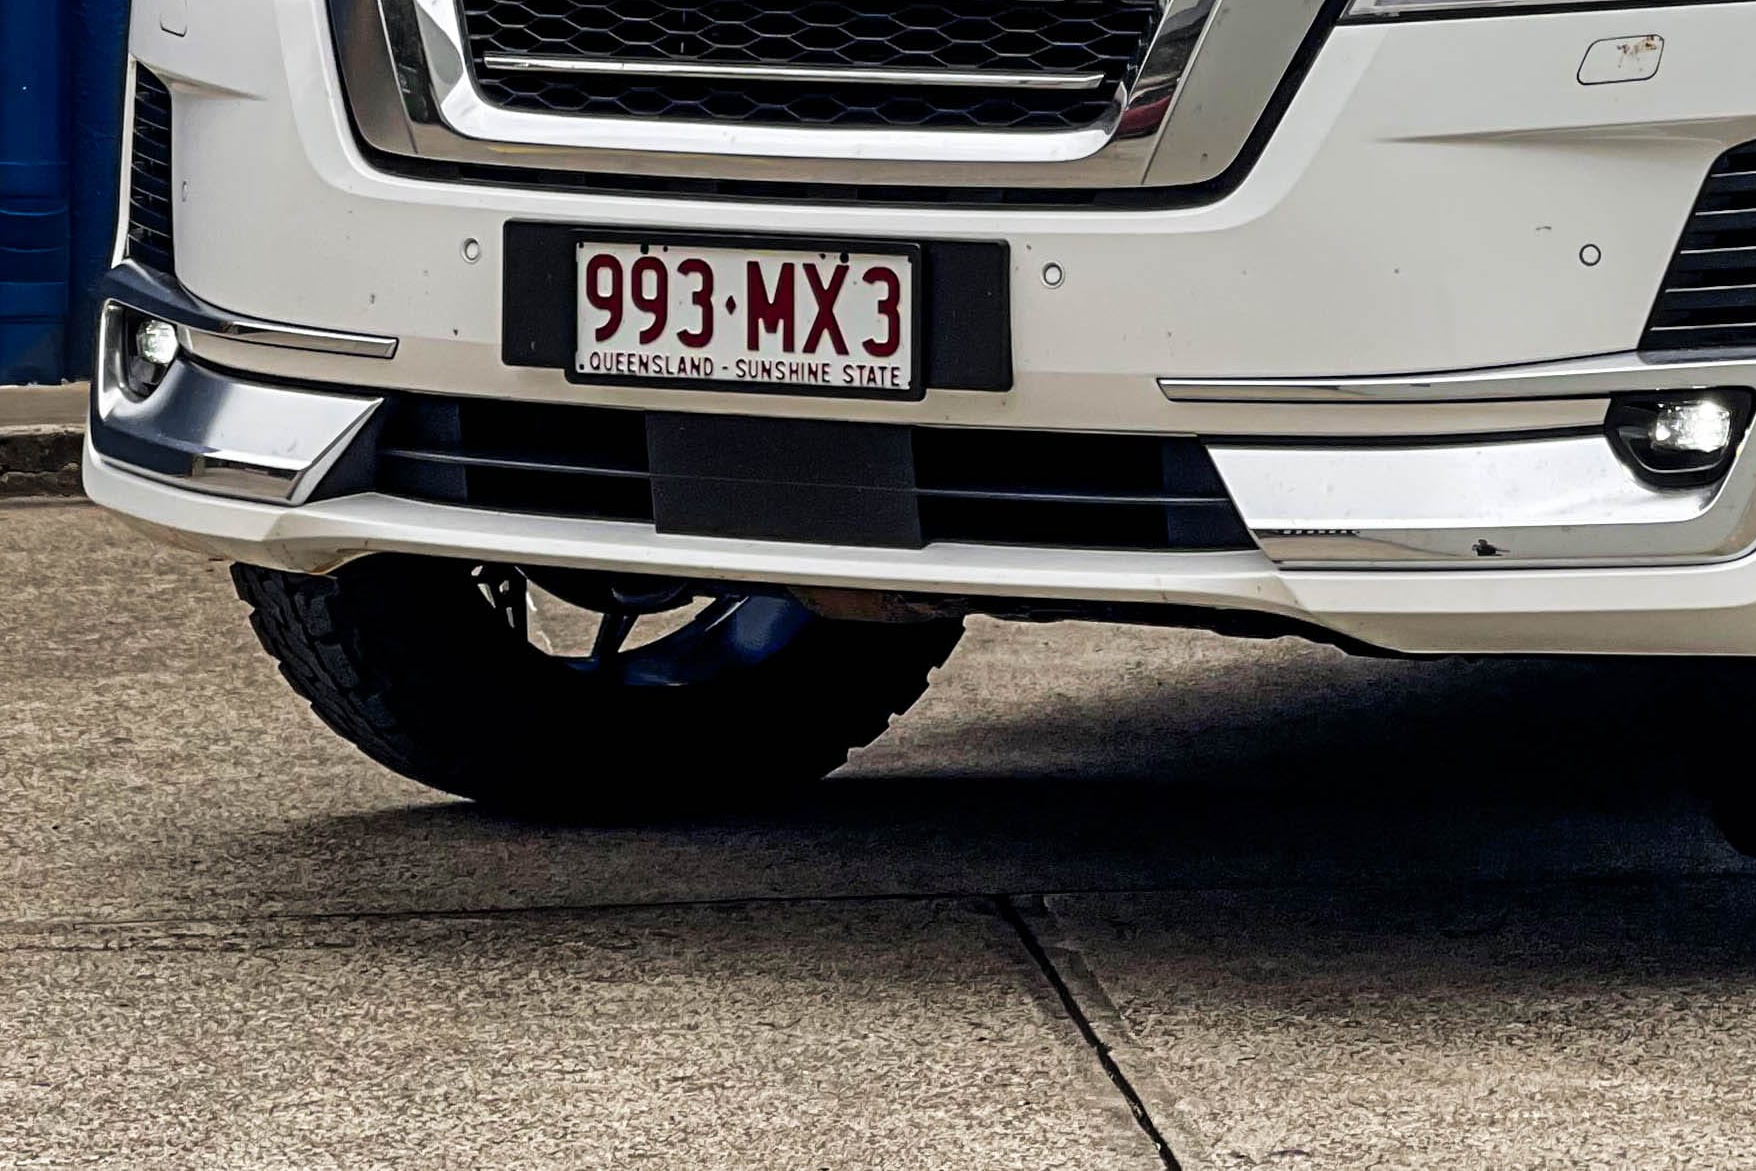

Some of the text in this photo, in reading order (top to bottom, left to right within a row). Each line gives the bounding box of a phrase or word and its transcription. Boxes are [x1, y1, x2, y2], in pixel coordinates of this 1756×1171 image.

[590, 351, 714, 378] QUEENSLAND
[736, 359, 831, 385] SUNSHINE
[842, 366, 901, 389] STATE
